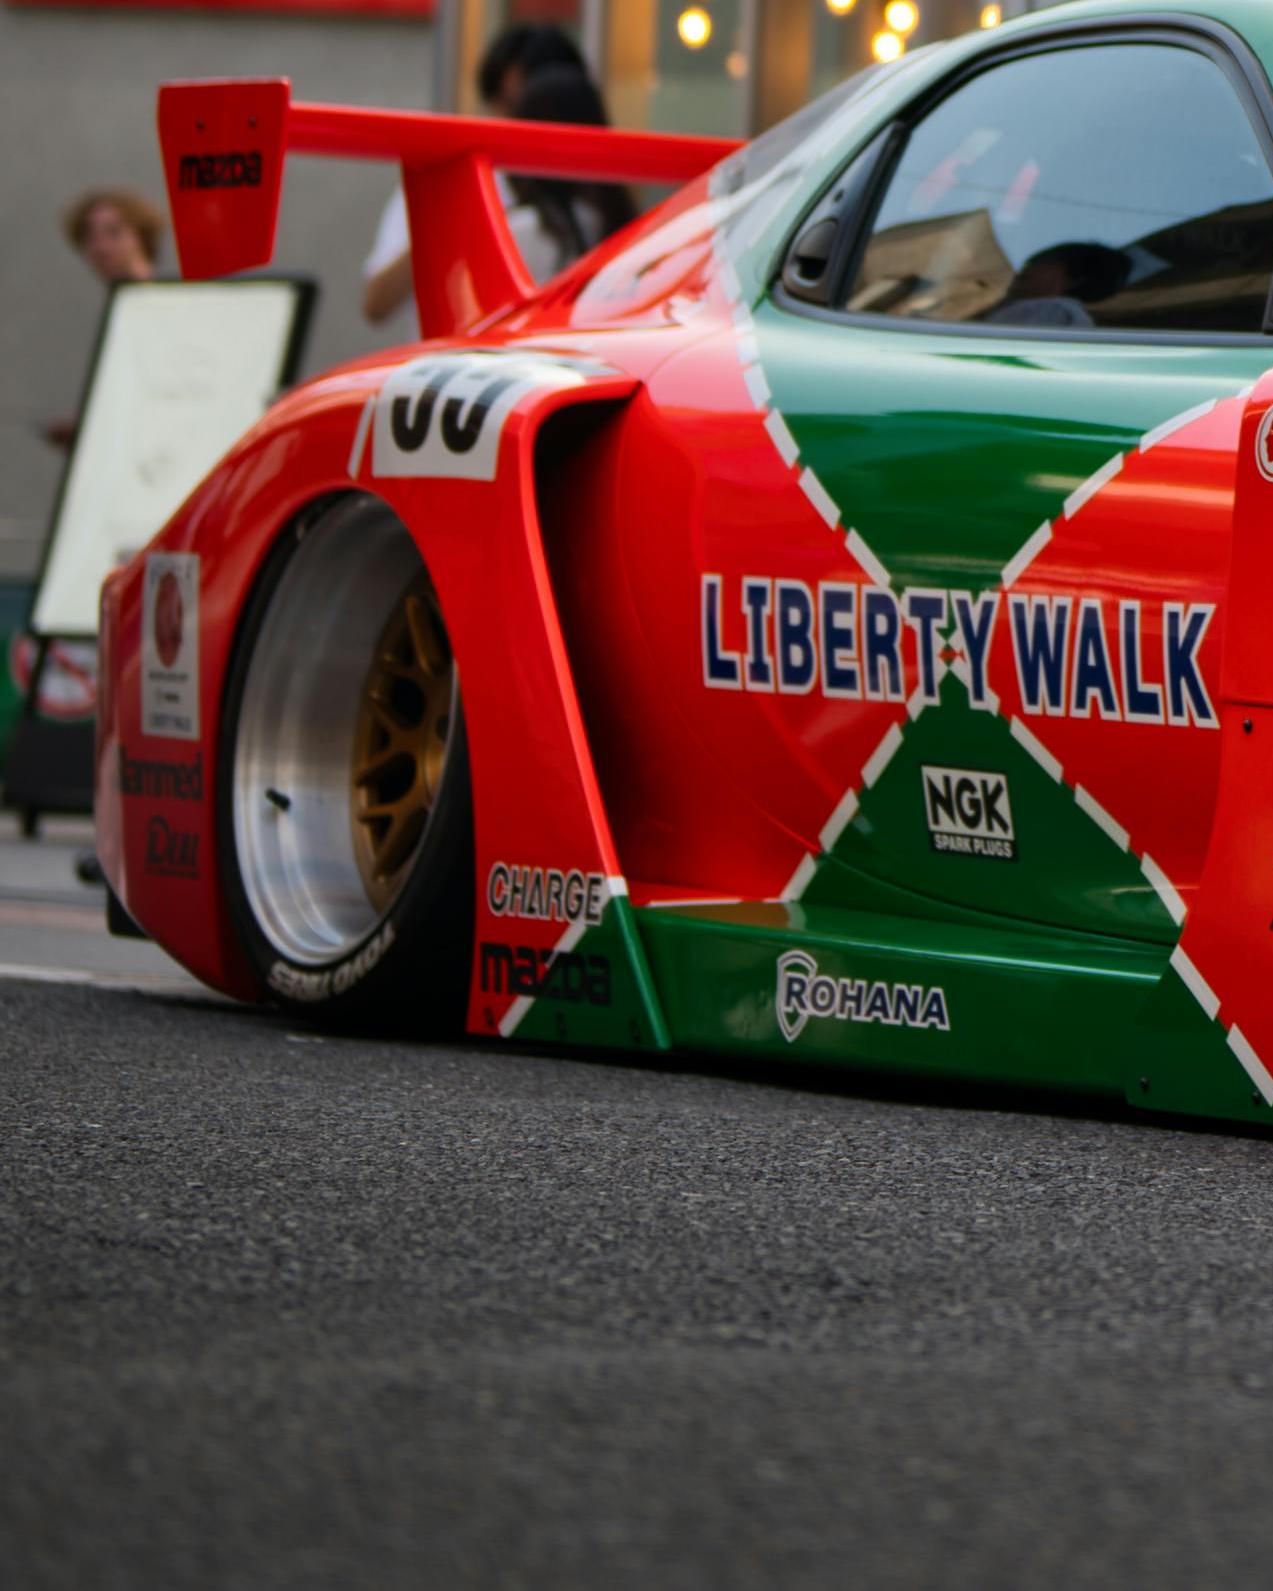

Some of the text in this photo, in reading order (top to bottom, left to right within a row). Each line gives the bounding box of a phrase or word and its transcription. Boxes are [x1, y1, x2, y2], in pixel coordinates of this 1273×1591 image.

[178, 149, 264, 193] mazda
[702, 573, 1221, 729] LIBERTY WALK
[925, 773, 1011, 836] NGK
[934, 832, 1013, 858] SPARK PLUGS
[486, 861, 606, 926] CHARGE
[480, 941, 612, 1007] mazda
[782, 970, 951, 1031] ROHANA
